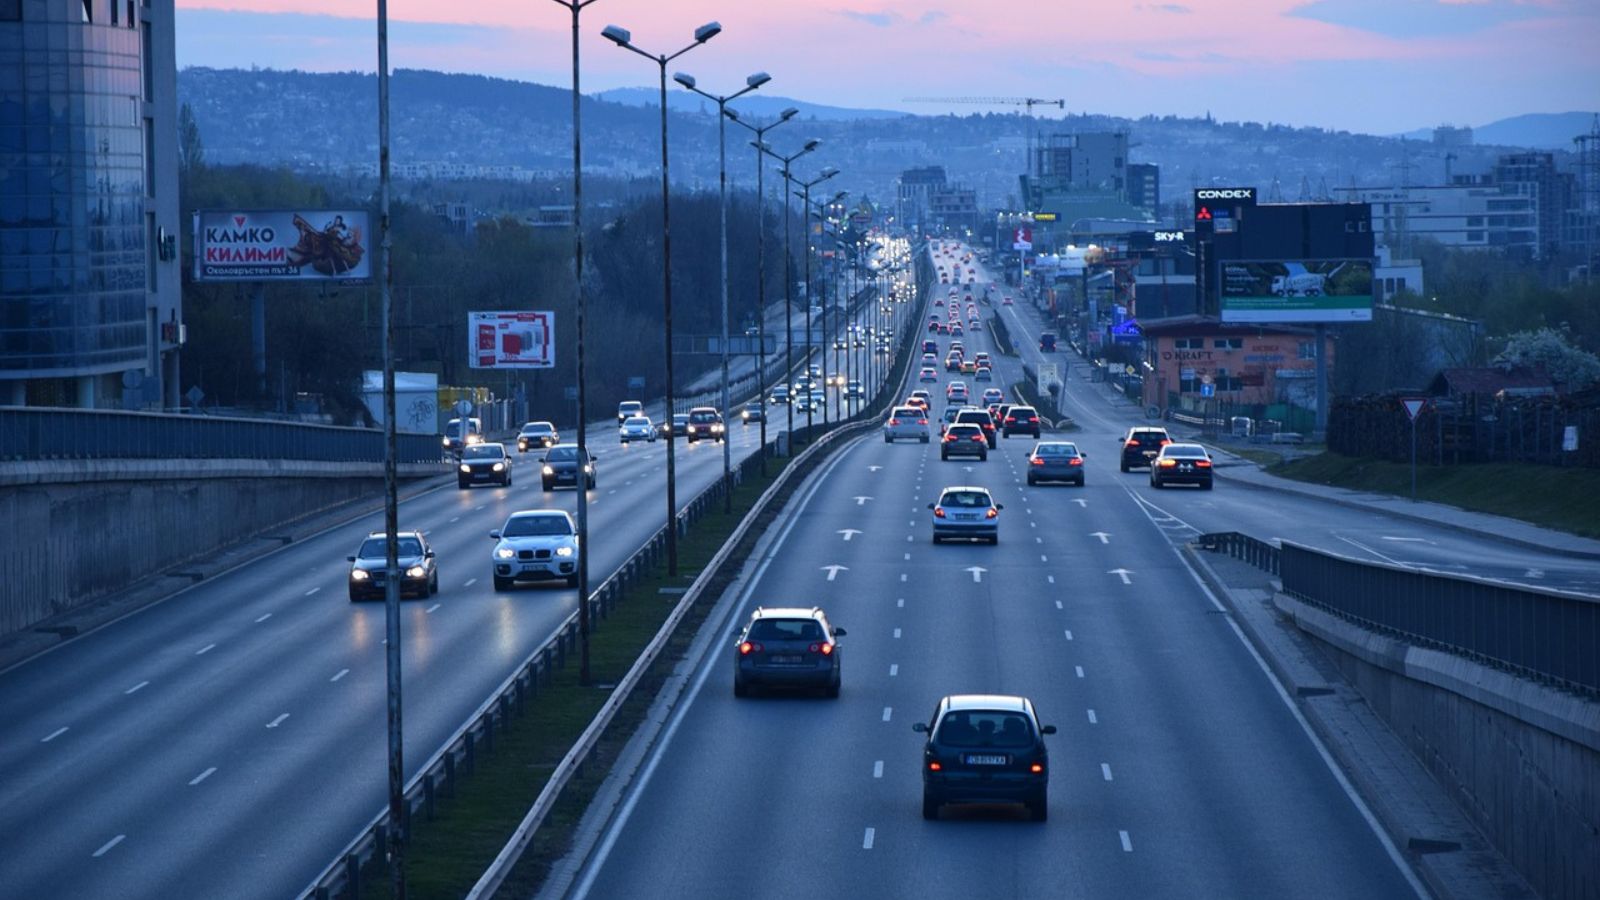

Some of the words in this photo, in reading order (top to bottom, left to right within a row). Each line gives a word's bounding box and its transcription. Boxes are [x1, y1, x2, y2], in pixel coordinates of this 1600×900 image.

[1197, 189, 1252, 199] CONDEX
[207, 228, 274, 243] КАМКО
[207, 247, 285, 262] КИЛИМИ
[1174, 351, 1214, 361] KRAFT
